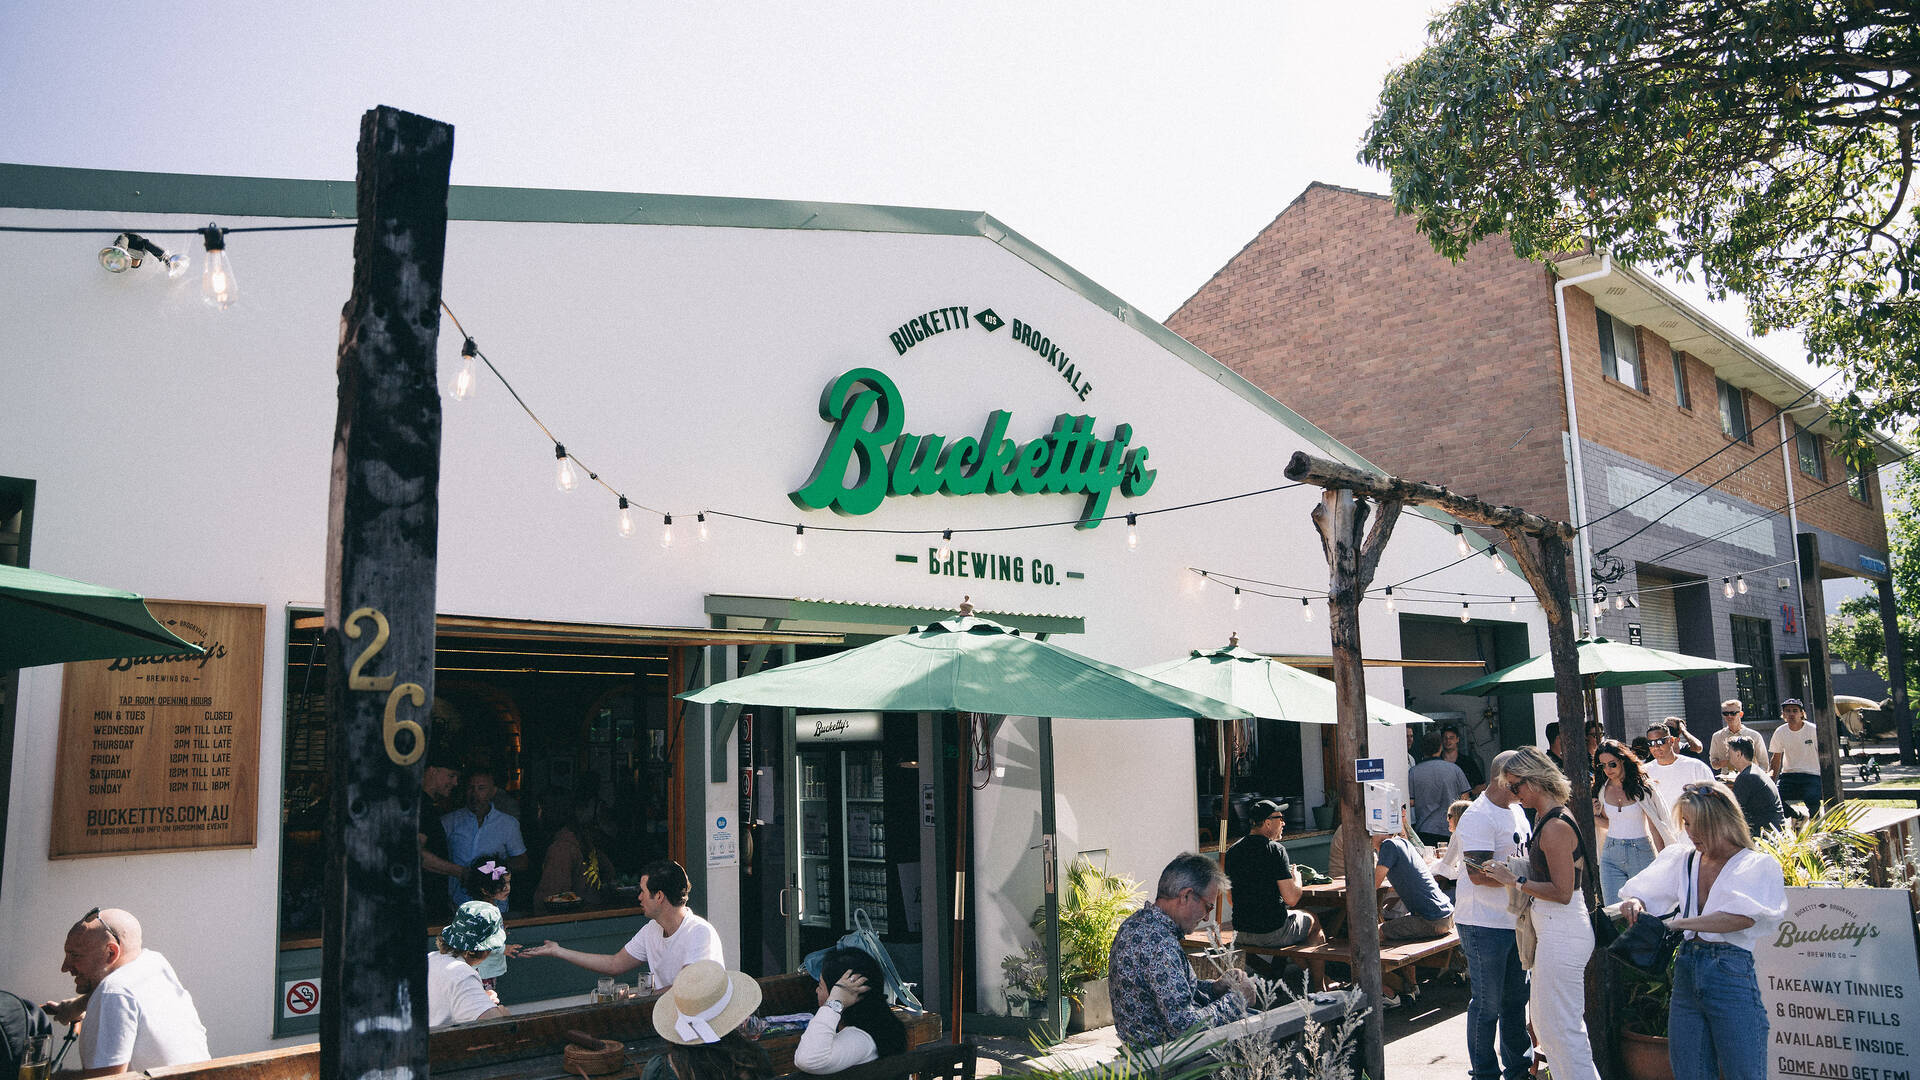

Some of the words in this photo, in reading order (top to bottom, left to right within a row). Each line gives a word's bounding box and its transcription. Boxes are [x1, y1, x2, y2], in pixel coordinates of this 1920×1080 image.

[889, 306, 969, 356] BUCKETTY
[984, 315, 997, 325] AUS
[1012, 318, 1093, 402] BROOKVALE
[787, 367, 1157, 531] Bucketty's
[929, 548, 1023, 583] BREWING
[146, 674, 178, 682] BREWING
[119, 696, 133, 705] TAP
[135, 696, 154, 705] ROOM
[158, 696, 188, 705] OPENING
[190, 696, 212, 705] HOURS
[94, 710, 112, 720] MON
[116, 711, 121, 720] &
[125, 710, 146, 720] TUES
[204, 711, 233, 721] CLOSED
[93, 725, 144, 735] WEDNESDAY
[174, 725, 190, 735] 3PM
[194, 725, 210, 735] TILL
[213, 725, 232, 735] LATE
[813, 719, 849, 737] Bucketty's
[92, 740, 134, 750] THURSDAY
[174, 739, 190, 749] 3PM
[193, 739, 210, 749] TILL
[213, 739, 232, 749] LATE
[91, 754, 120, 765] FRIDAY
[169, 753, 189, 763] 12PM
[192, 753, 209, 763] TILL
[212, 753, 231, 763] LATE
[89, 768, 131, 779] SATURDAY
[169, 768, 188, 777] 12PM
[192, 767, 208, 777] TILL
[211, 767, 231, 777] LATE
[89, 783, 122, 794] SUNDAY
[169, 782, 188, 792] 12PM
[192, 781, 208, 791] TILL
[87, 804, 229, 826] BUCKETTYS.COM.AU
[1773, 921, 1881, 948] Bucketty's
[1768, 975, 1842, 994] TAKEAWAY
[1844, 980, 1904, 999] TINNIES
[1776, 1003, 1785, 1017] &
[1788, 1003, 1854, 1023] GROWLER
[1858, 1010, 1900, 1027] FILLS
[1775, 1031, 1852, 1050] AVAILABLE
[1855, 1038, 1909, 1057] INSIDE.
[1778, 1056, 1816, 1075] COME
[1819, 1063, 1849, 1078] AND
[1852, 1066, 1880, 1080] GET
